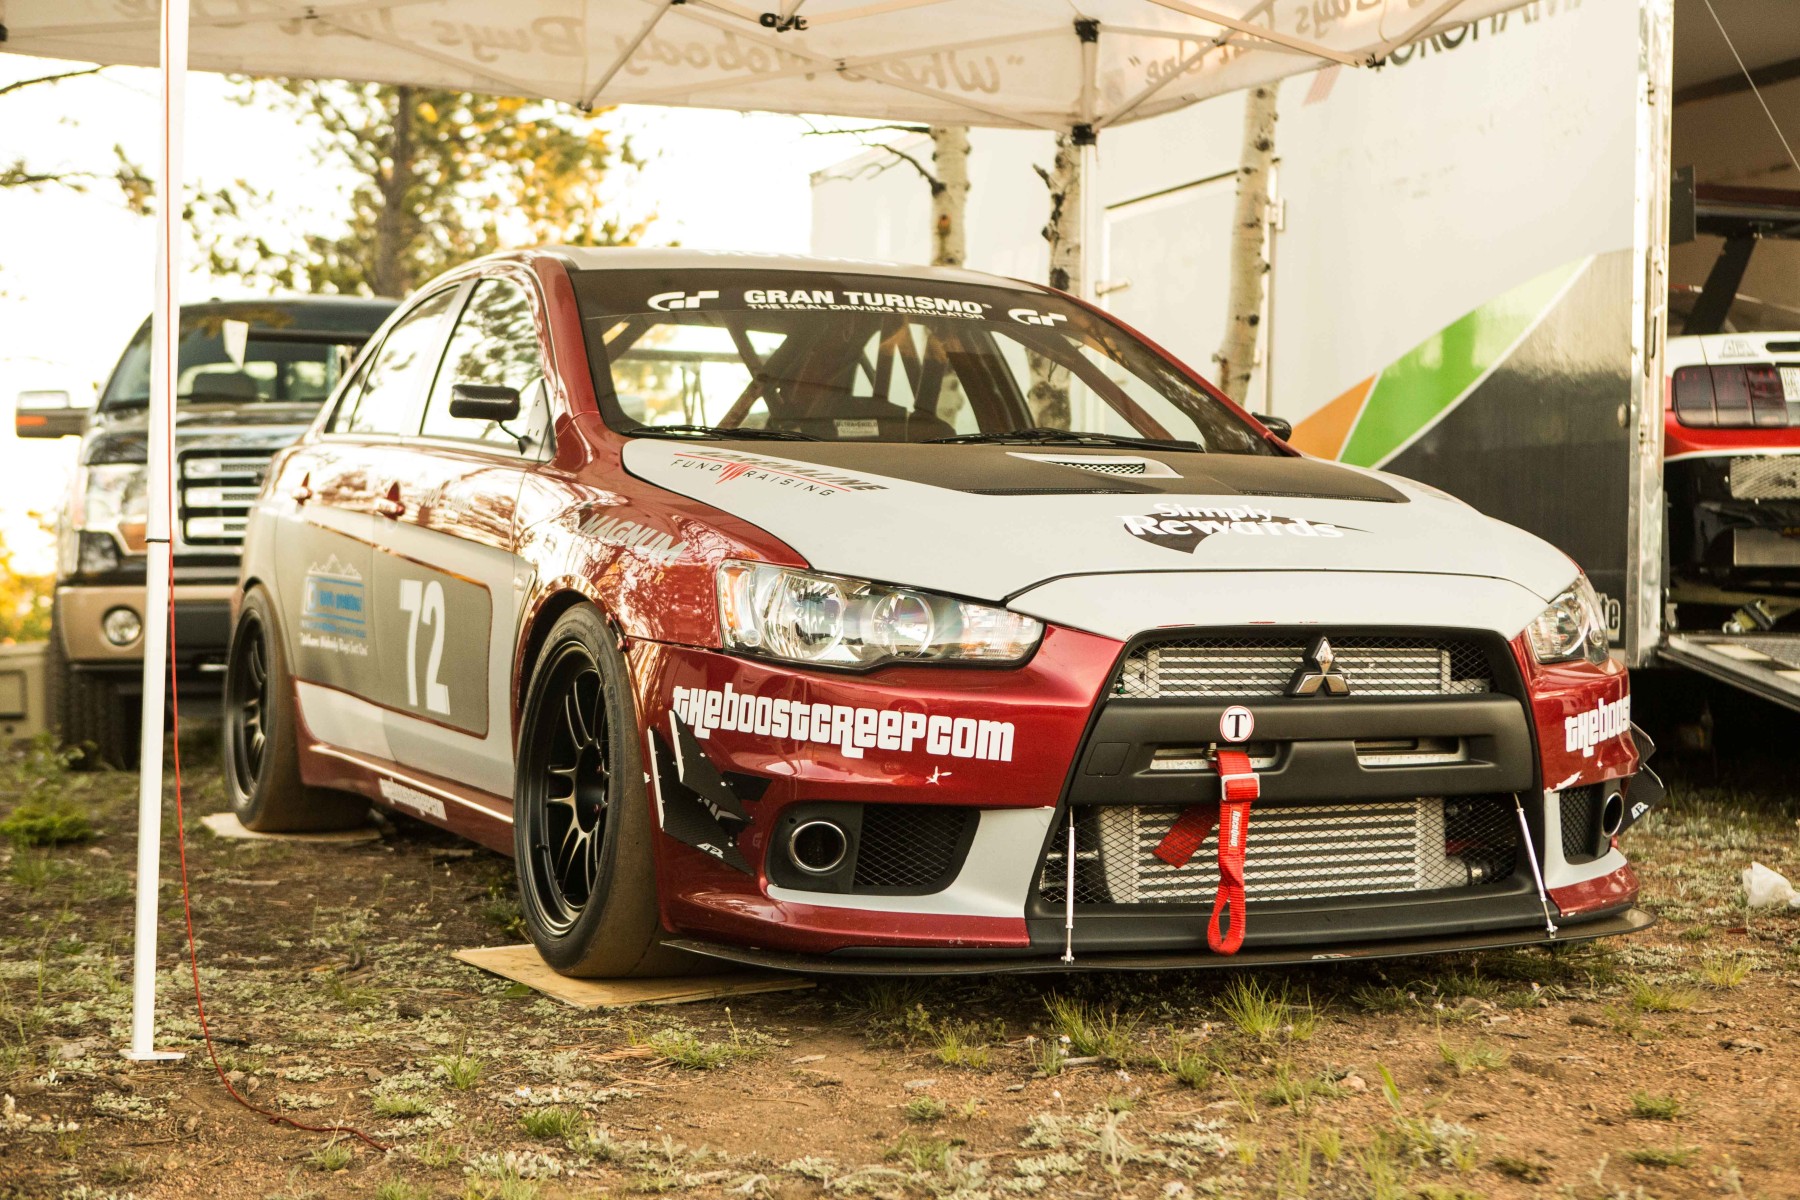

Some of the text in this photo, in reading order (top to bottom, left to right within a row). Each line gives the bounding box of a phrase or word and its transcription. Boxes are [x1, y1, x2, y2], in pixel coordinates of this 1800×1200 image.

[744, 290, 835, 304] GRAN
[829, 305, 894, 313] DRIVING
[897, 307, 986, 320] SIMULATOR
[670, 459, 835, 497] FUND RAISING
[1153, 503, 1272, 522] Simply
[1115, 515, 1344, 538] Rewards
[578, 513, 690, 567] MAGNUM
[400, 579, 451, 716] 72
[1228, 713, 1247, 738] T
